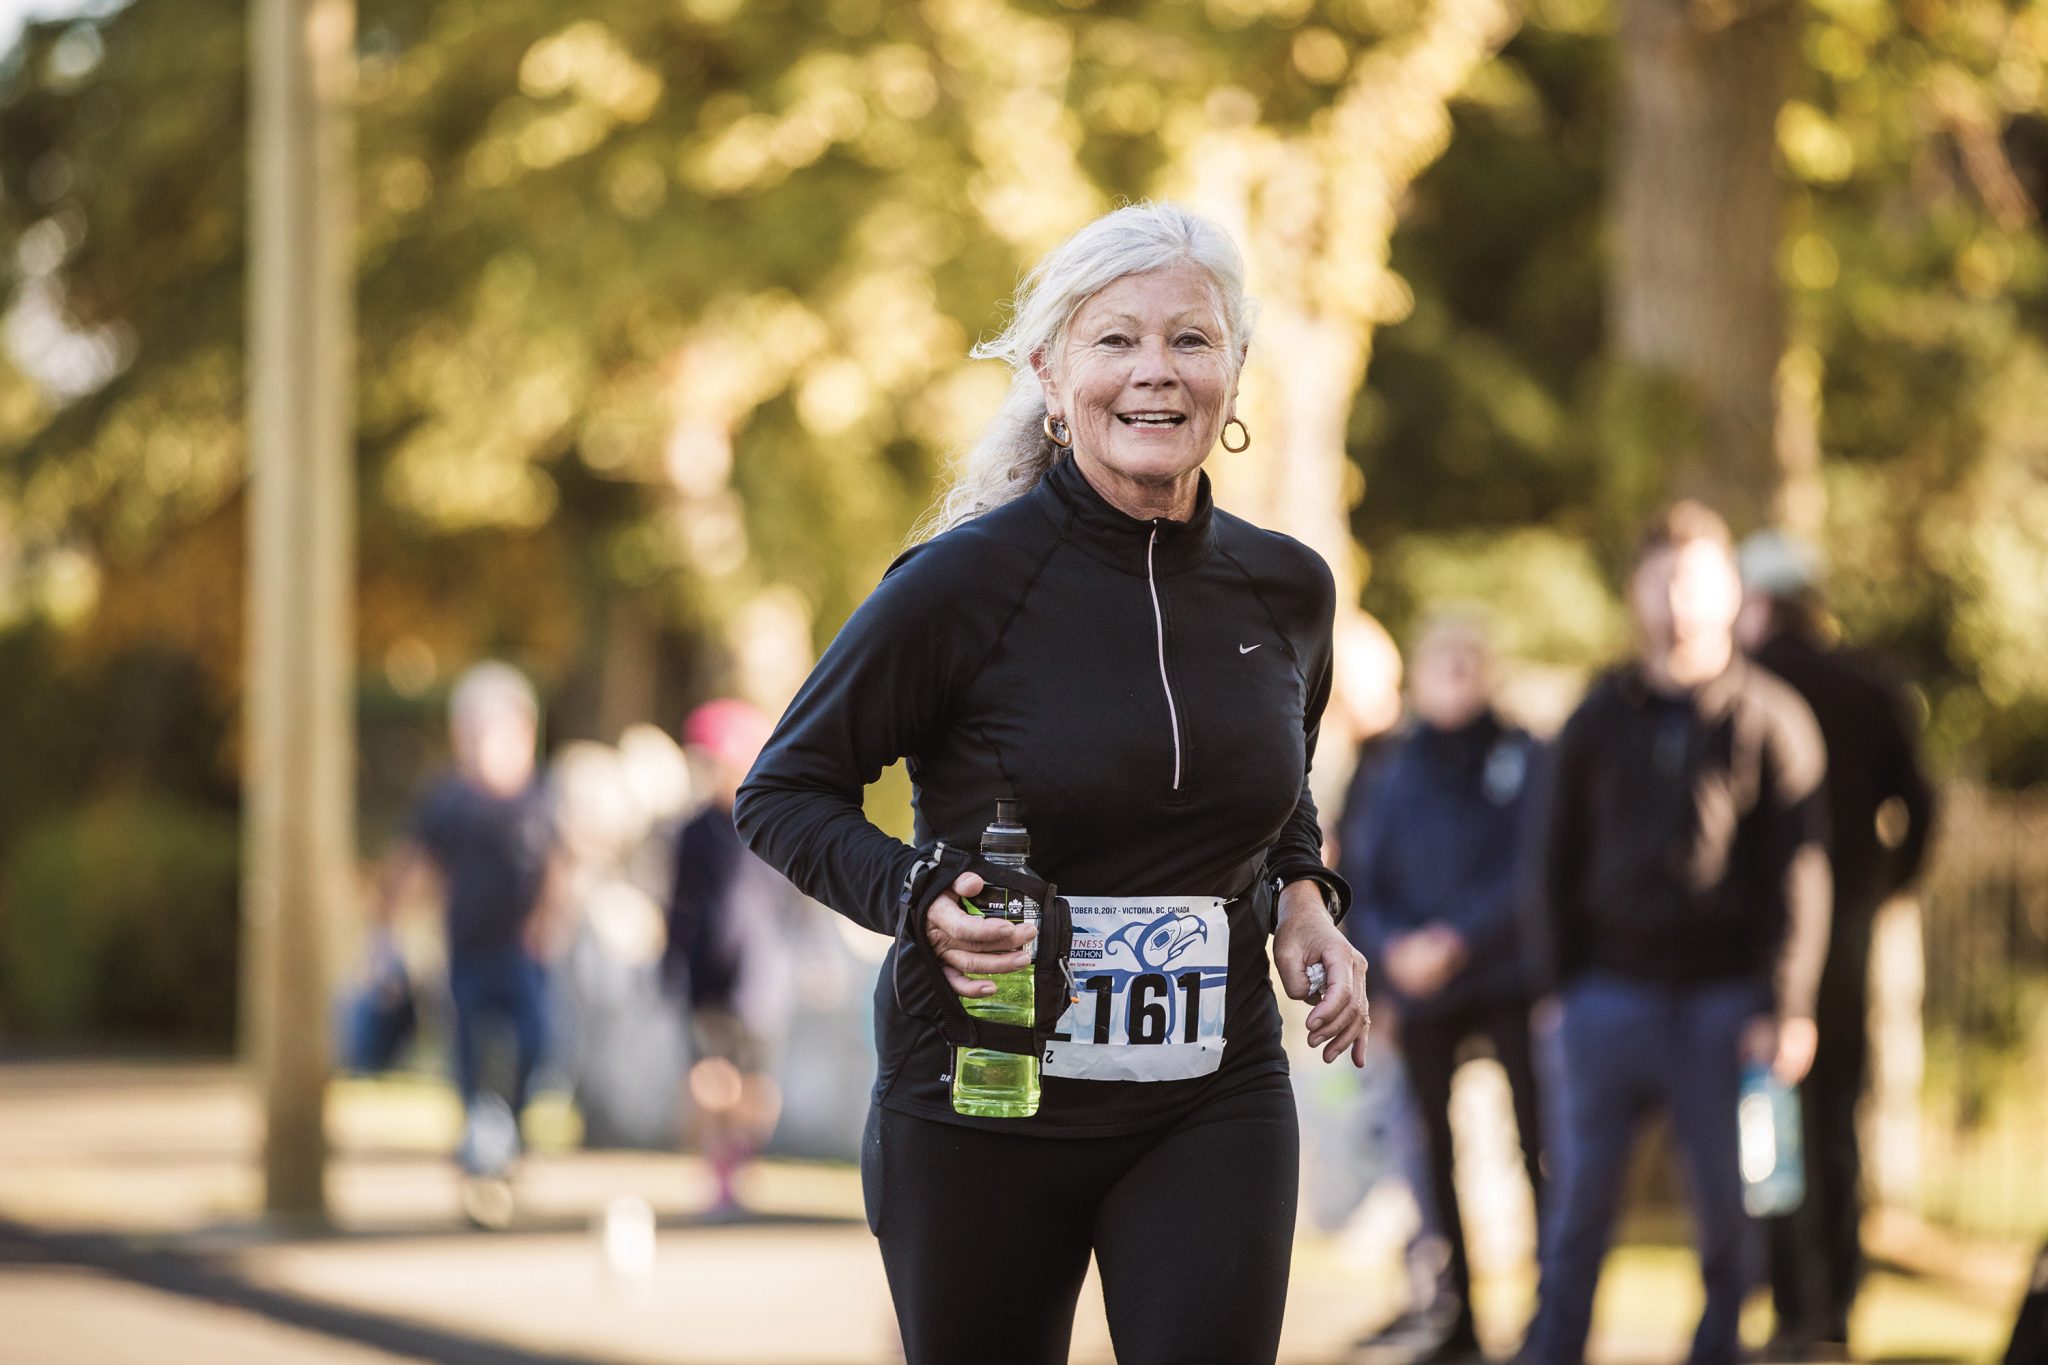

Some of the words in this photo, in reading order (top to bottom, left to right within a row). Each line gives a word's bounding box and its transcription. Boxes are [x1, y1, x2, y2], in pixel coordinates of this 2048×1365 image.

[1071, 906, 1093, 915] TOBER
[1101, 906, 1117, 915] 2017
[1122, 906, 1154, 915] VICTORIA,
[1155, 906, 1167, 914] BC,
[1167, 906, 1190, 914] CANADA
[1072, 939, 1104, 949] TNESS
[1070, 950, 1102, 959] RATHON
[1055, 971, 1201, 1045] 161
